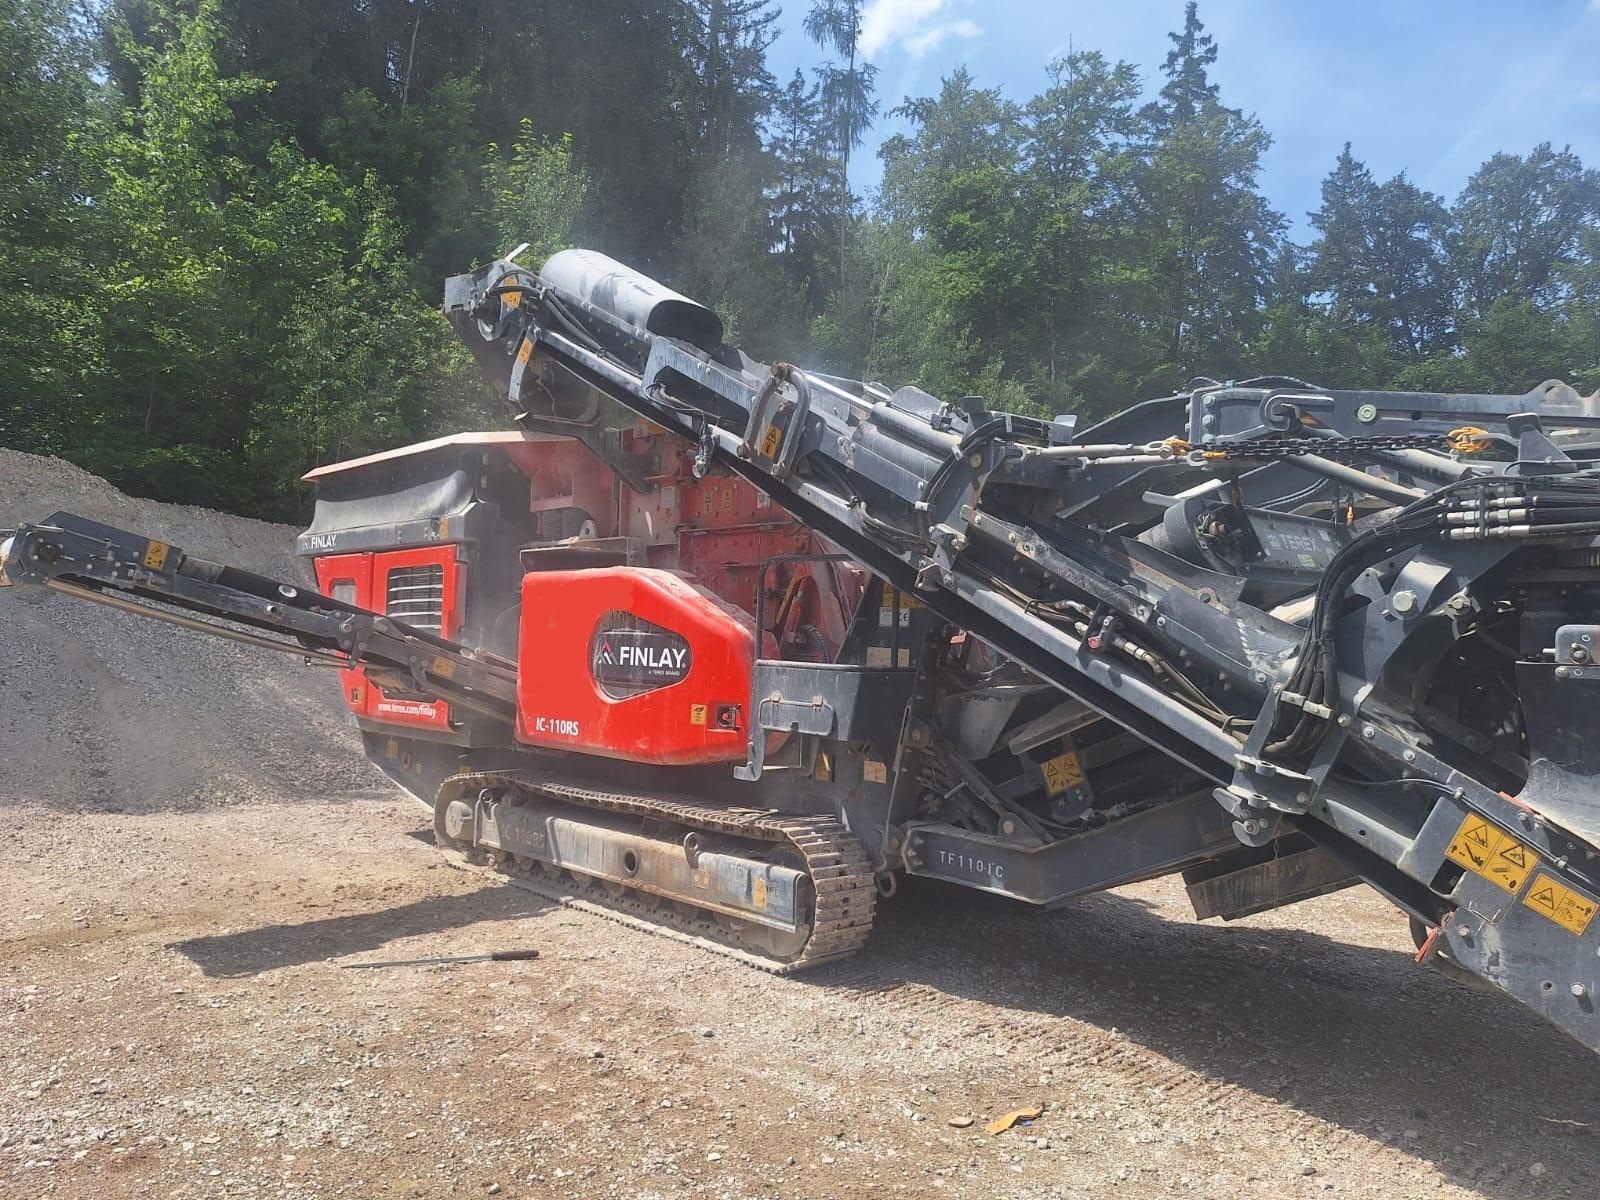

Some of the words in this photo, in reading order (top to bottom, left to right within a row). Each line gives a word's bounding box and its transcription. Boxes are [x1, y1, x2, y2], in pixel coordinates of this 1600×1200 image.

[311, 534, 336, 549] FINLAY
[1279, 534, 1317, 552] TEREX
[619, 646, 687, 668] FINLAY
[536, 717, 579, 736] IC-110RS
